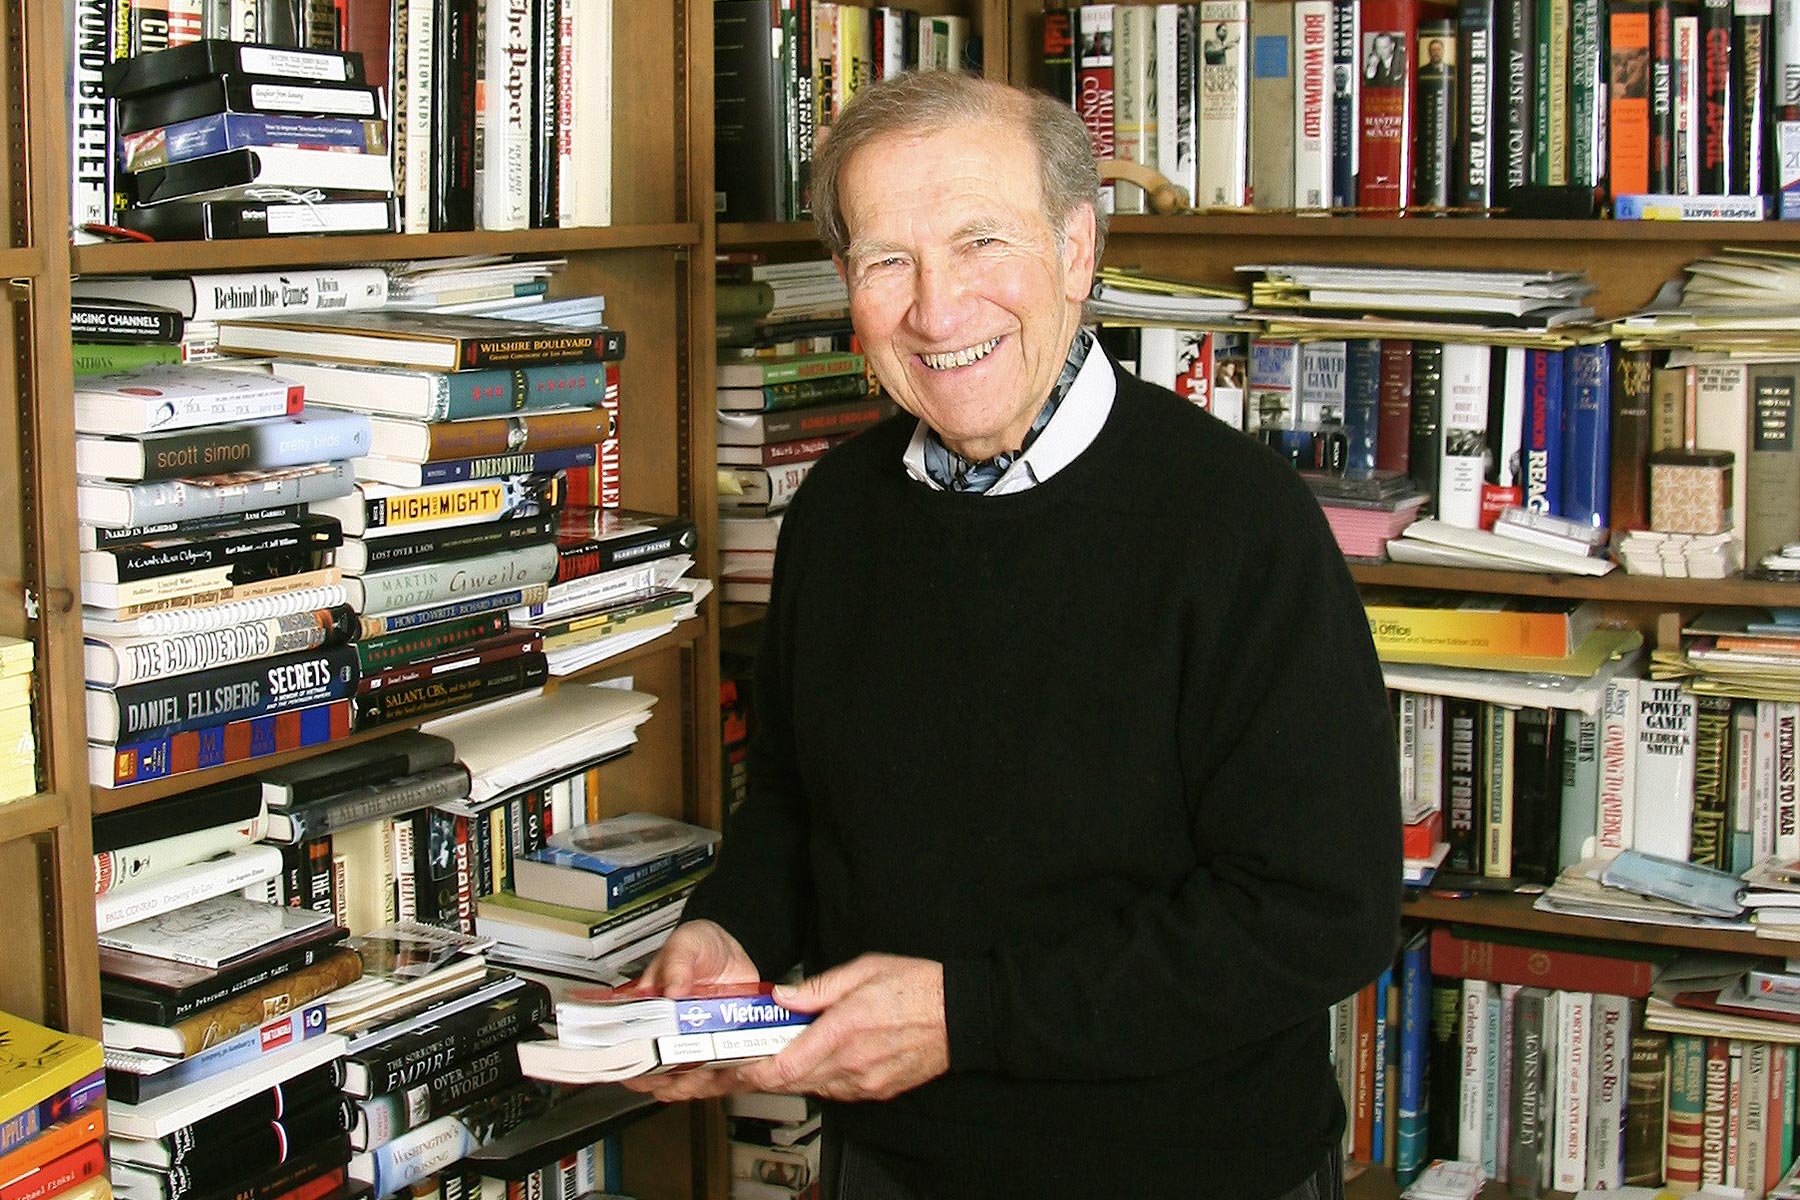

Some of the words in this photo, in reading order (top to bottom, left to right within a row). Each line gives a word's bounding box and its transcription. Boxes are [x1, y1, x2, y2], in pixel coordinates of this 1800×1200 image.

[1304, 14, 1325, 45] BOB
[1472, 30, 1487, 59] THE
[419, 37, 429, 89] YELLOW
[1510, 50, 1524, 105] ABUSE
[503, 43, 528, 130] Paper
[1304, 48, 1324, 138] WOODWARD
[1470, 63, 1486, 136] KENNEDY
[1552, 87, 1563, 110] WAR
[1655, 63, 1670, 115] JUSTICE
[418, 95, 429, 130] KIDS
[544, 82, 554, 137] SMITH
[798, 77, 811, 163] OKINAWA
[1365, 116, 1400, 126] MASTER
[79, 80, 106, 192] BELIEF
[1366, 129, 1399, 138] SENATE
[1469, 140, 1485, 186] TAPES
[1508, 129, 1524, 189] POWER
[214, 285, 257, 311] Behind
[260, 284, 279, 308] the
[108, 313, 160, 329] CHANNELS
[480, 341, 530, 354] WILSHIRE
[533, 337, 593, 351] BOULEVARD
[1308, 372, 1339, 390] GIANT
[1534, 383, 1547, 449] CANNON
[157, 447, 199, 469] scott
[204, 442, 251, 464] simon
[313, 433, 340, 450] birds
[470, 453, 536, 479] ANDERSONVILLE
[1529, 450, 1549, 513] REAG
[390, 501, 430, 520] HIGH
[439, 488, 501, 515] MIGHTY
[142, 522, 179, 537] BAGHDAD
[371, 550, 390, 561] LOST
[391, 547, 412, 558] OVER
[414, 543, 435, 555] LAOS
[382, 572, 439, 592] MARTIN
[385, 589, 434, 608] BOOTH
[449, 561, 528, 594] Gweilo
[393, 615, 416, 628] HOW
[417, 612, 430, 624] TO
[430, 608, 456, 623] WRITE
[1378, 623, 1411, 637] Office
[125, 644, 160, 681] THE
[162, 621, 270, 673] CONQUERORS
[1407, 637, 1420, 645] and
[127, 697, 183, 733] DANIEL
[187, 680, 261, 721] ELLSBERG
[267, 658, 332, 696] SECRETS
[1641, 701, 1692, 716] POWER
[1652, 687, 1680, 700] THE
[1578, 721, 1595, 762] STALIN'S
[1646, 717, 1687, 731] GAME
[1452, 717, 1473, 773] BRUTE
[1779, 716, 1795, 783] WITNESS
[360, 801, 383, 816] THE
[1451, 775, 1473, 831] FORCE
[1780, 785, 1794, 804] TO
[1780, 804, 1794, 837] WAR
[312, 869, 331, 900] THE
[105, 906, 125, 923] PAUL
[125, 899, 159, 917] CONRAD
[719, 1000, 791, 1024] Vietnam
[1465, 994, 1482, 1044] Carleton
[722, 1036, 742, 1050] the
[743, 1036, 769, 1049] man
[1572, 1004, 1583, 1063] PORTRAIT
[1603, 1010, 1621, 1054] BLACK
[385, 1048, 456, 1093] EMPIRE
[386, 1057, 403, 1073] THE
[433, 1069, 464, 1091] OVER
[471, 1051, 501, 1073] EDGE
[1463, 1046, 1479, 1078] Beals
[1523, 1033, 1540, 1078] AGNES
[1602, 1055, 1617, 1073] ON
[450, 1066, 500, 1100] WORLD
[1601, 1073, 1618, 1104] RED
[1706, 1059, 1727, 1113] CHINA
[1519, 1083, 1538, 1148] SMEDLEY
[1567, 1097, 1579, 1160] EXPLORER
[392, 1122, 460, 1165] WASHINGTON'S
[1702, 1114, 1725, 1186] DOCTOR
